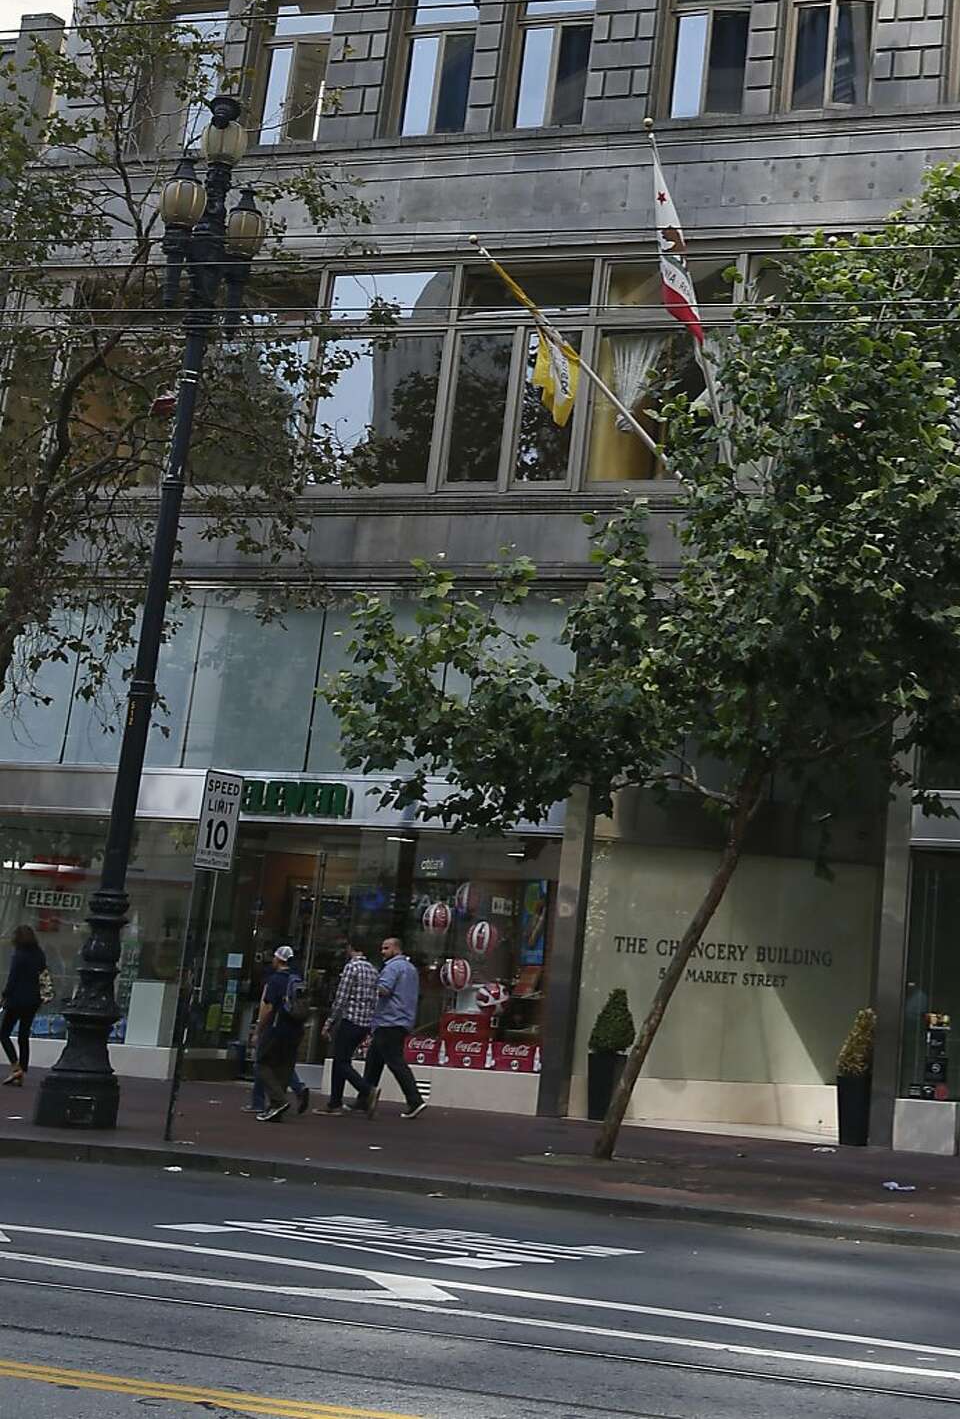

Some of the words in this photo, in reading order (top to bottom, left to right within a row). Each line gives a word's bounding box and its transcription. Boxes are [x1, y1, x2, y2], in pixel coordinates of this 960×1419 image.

[208, 779, 241, 797] SPEED
[207, 799, 235, 815] LIMIT
[205, 818, 229, 851] 10
[614, 935, 648, 955] THE
[656, 938, 749, 963] CHNCERY
[756, 945, 833, 968] BUILDING
[685, 968, 738, 986] MARKET
[742, 973, 788, 989] STREET
